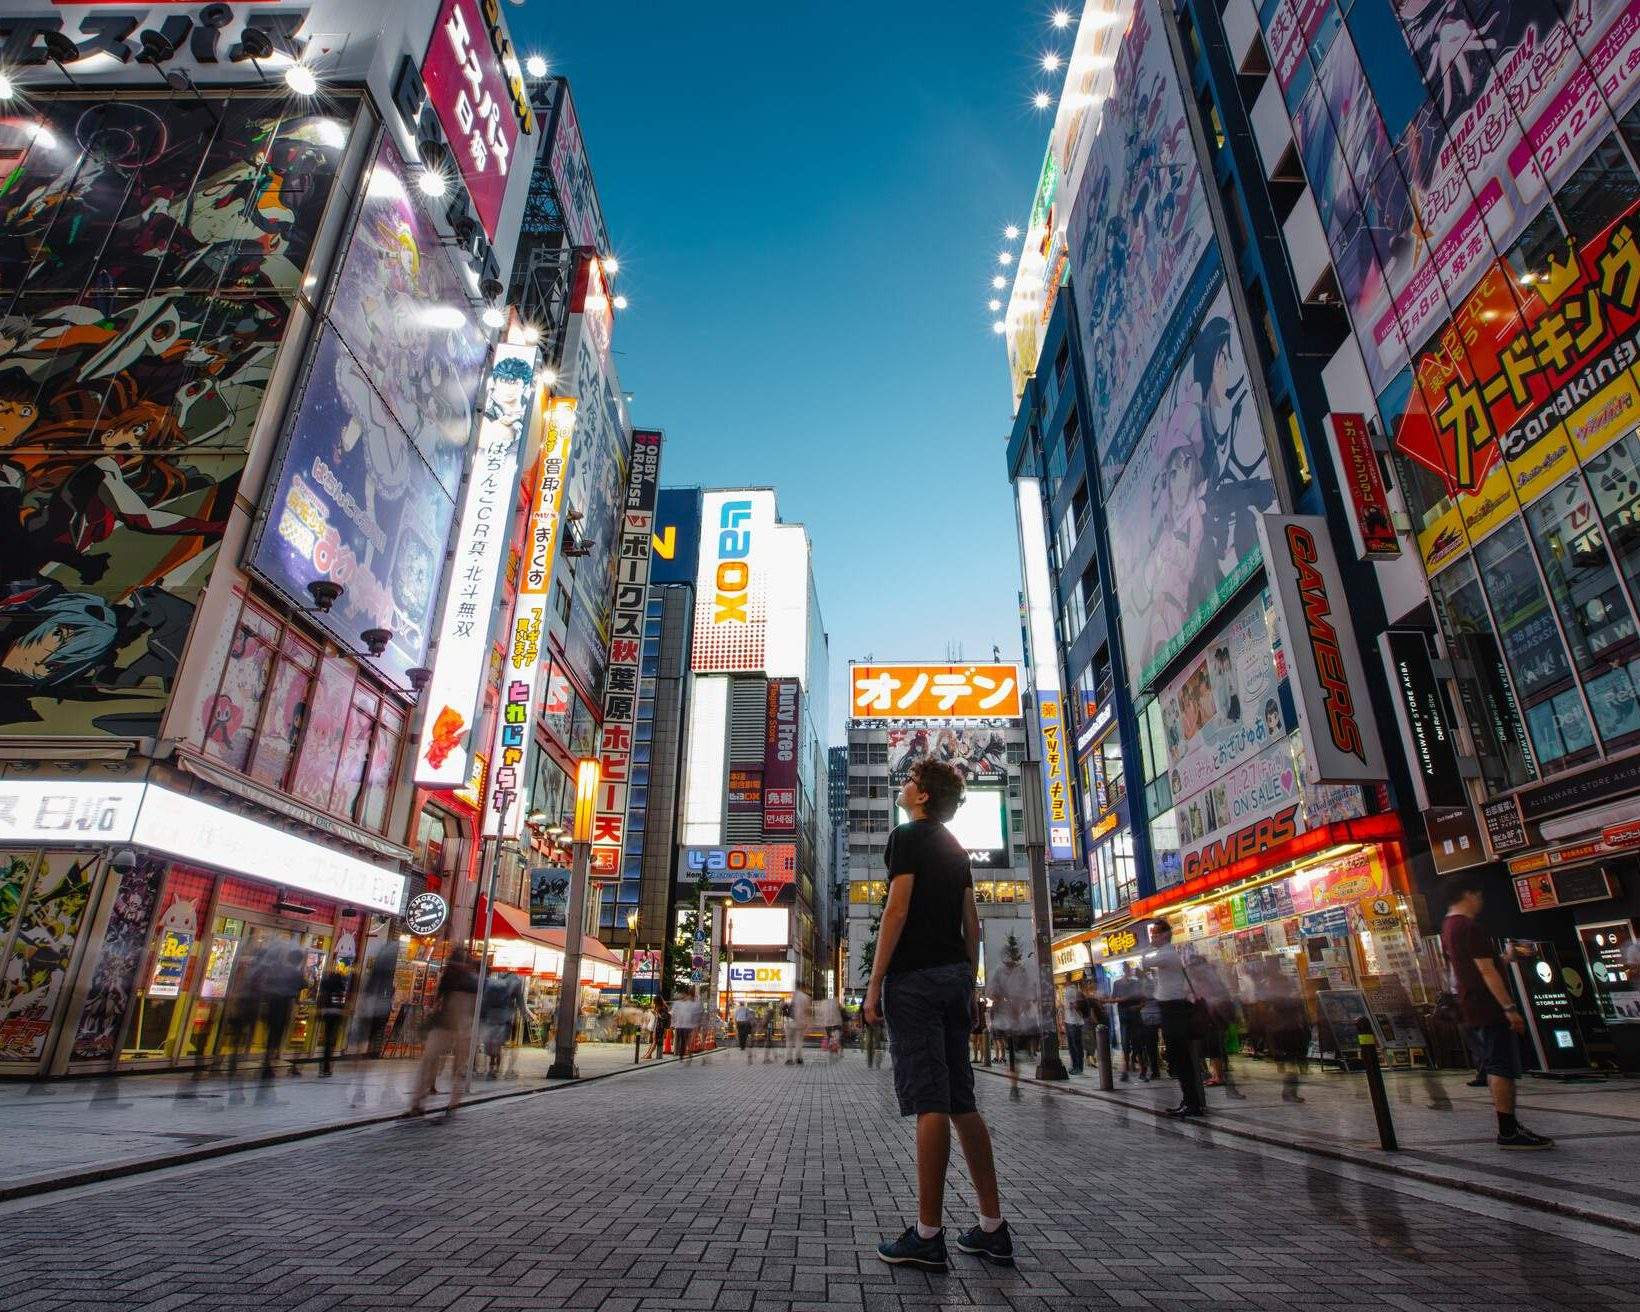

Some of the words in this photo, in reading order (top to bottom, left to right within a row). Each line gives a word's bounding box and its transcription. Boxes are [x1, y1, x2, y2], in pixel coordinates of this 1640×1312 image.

[1439, 224, 1640, 487] カードキング
[628, 434, 647, 507] PARADISE
[645, 434, 662, 485] HOBBY
[524, 607, 543, 667] フィギュア
[1284, 523, 1367, 767] GAMERS
[856, 667, 1015, 711] オノデン
[1399, 660, 1415, 688] AKIBA
[590, 535, 650, 877] ボークス秋葉原ホビー天国
[1406, 689, 1421, 719] STORE
[1042, 725, 1066, 821] マツモトキヨシ
[1413, 720, 1434, 775] ALIENWARE
[767, 792, 793, 805] 免税
[1233, 797, 1249, 817] ON
[1250, 777, 1282, 809] SALE
[1182, 804, 1300, 882] GAMERS
